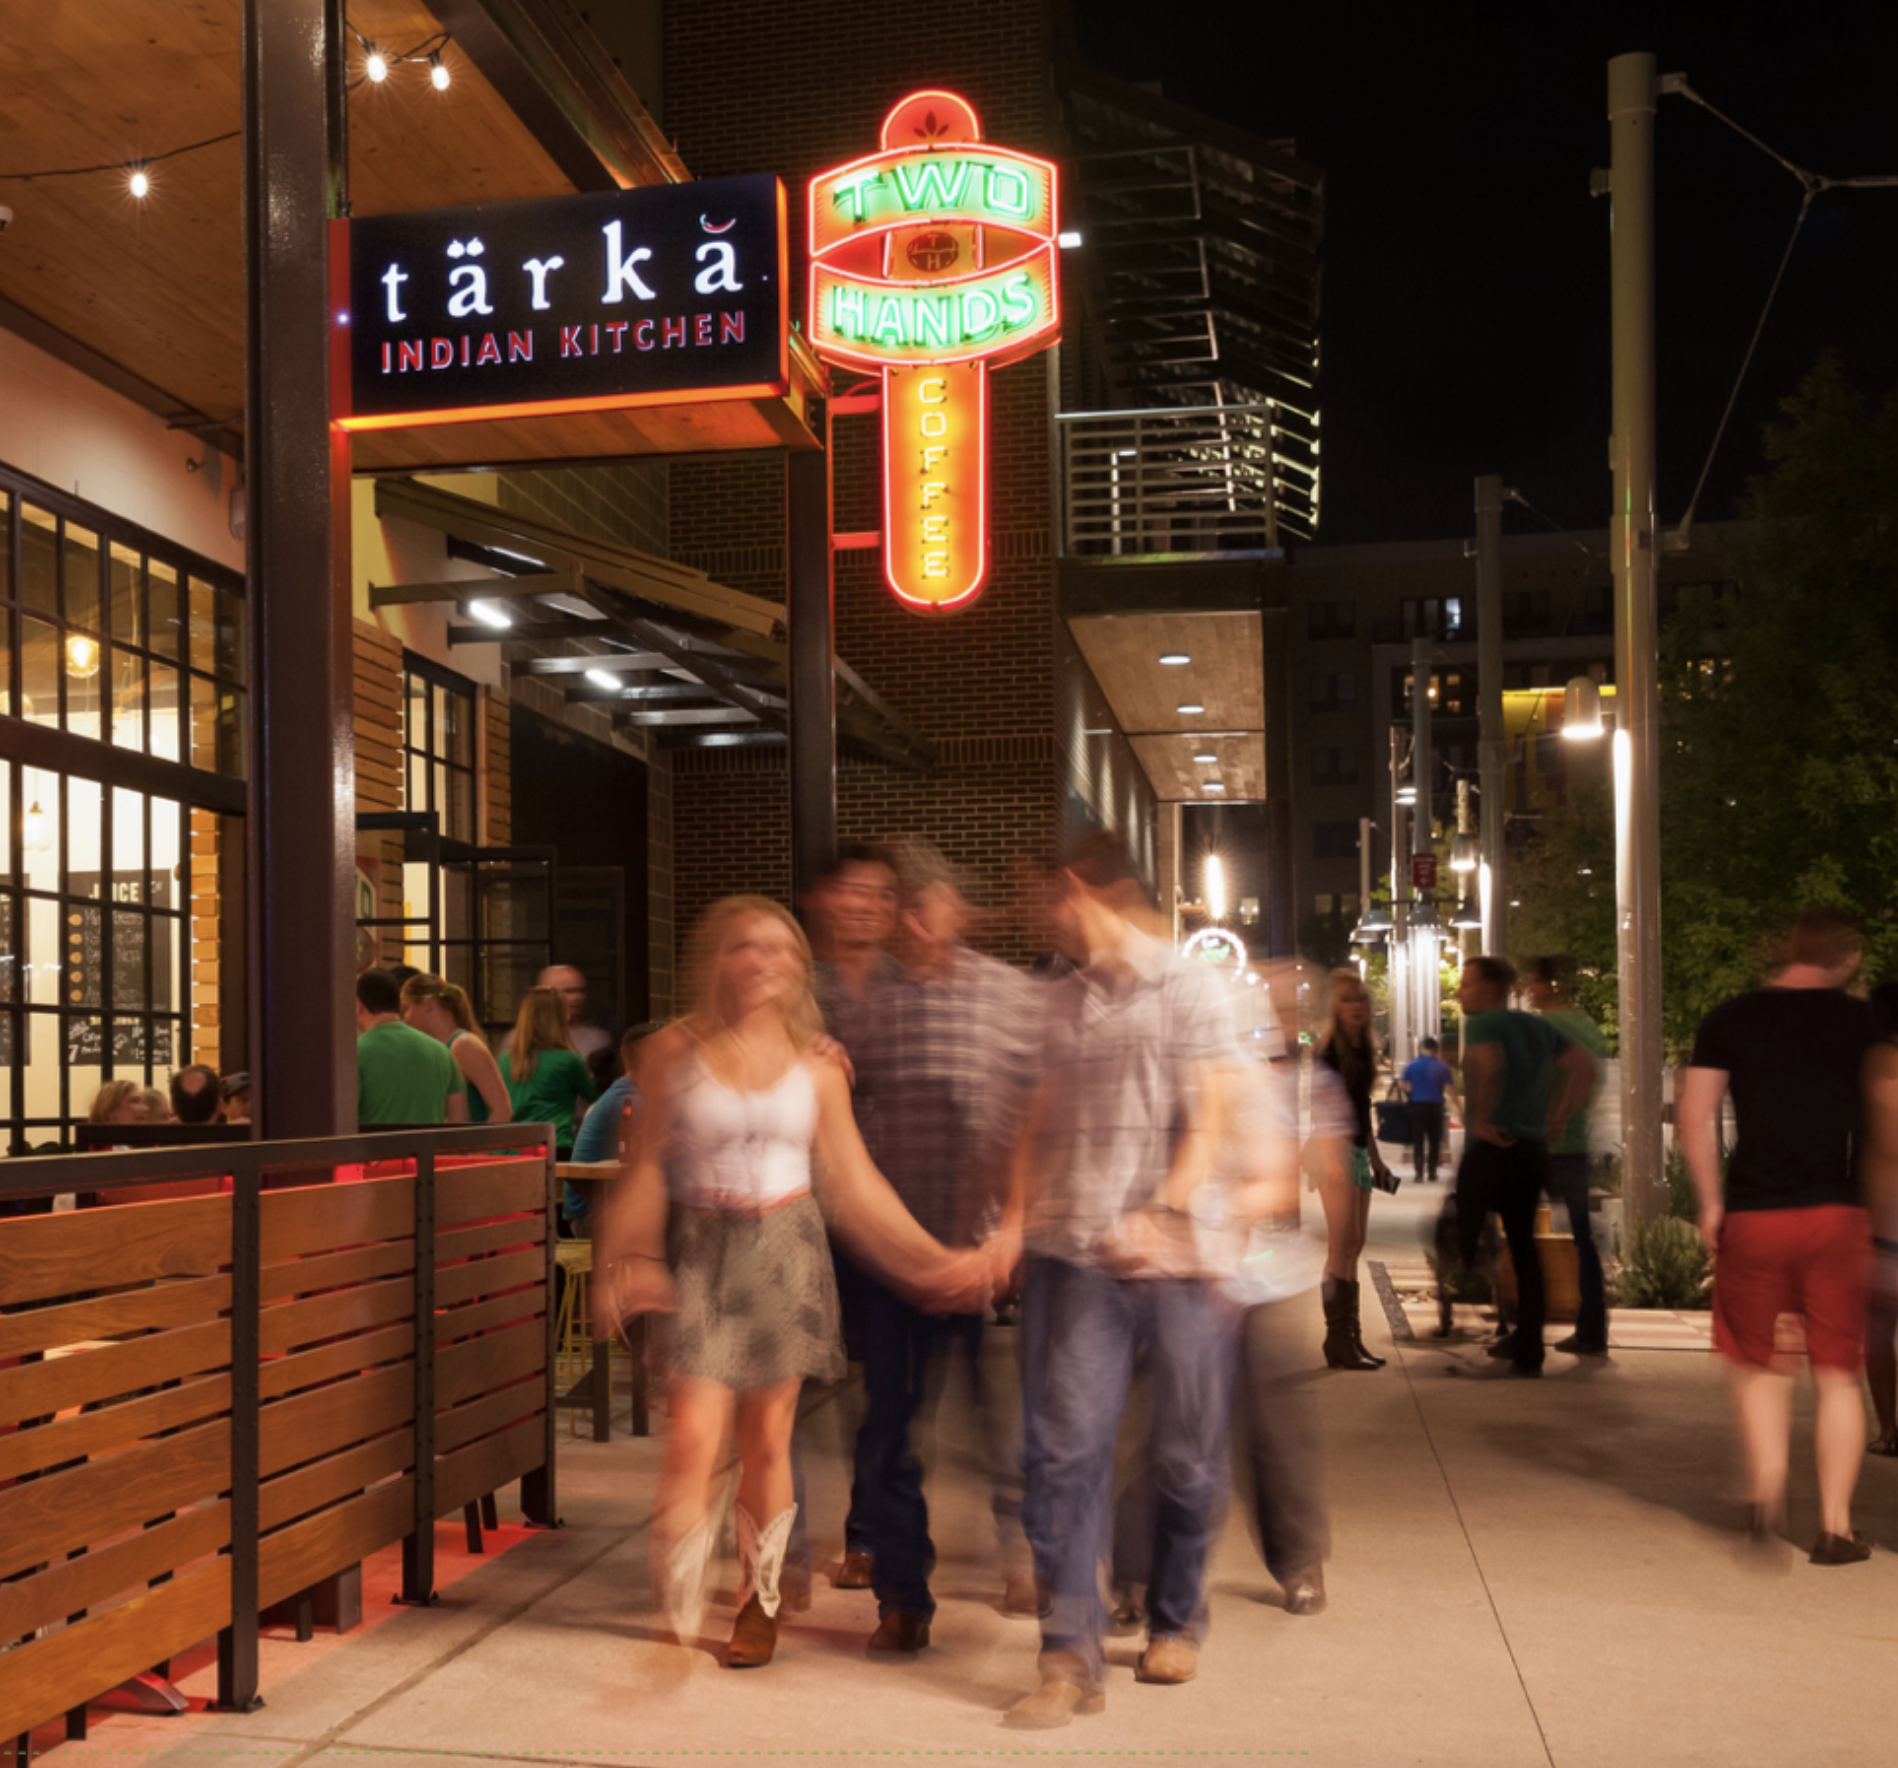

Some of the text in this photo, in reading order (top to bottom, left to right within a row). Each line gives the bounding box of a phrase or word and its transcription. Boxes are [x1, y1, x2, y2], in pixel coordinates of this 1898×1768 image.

[833, 160, 1034, 224] TWO
[833, 272, 1037, 346] HANDS
[381, 310, 746, 374] INDIAN KITCHEN
[919, 377, 950, 579] COFFEE
[88, 882, 139, 903] JICE
